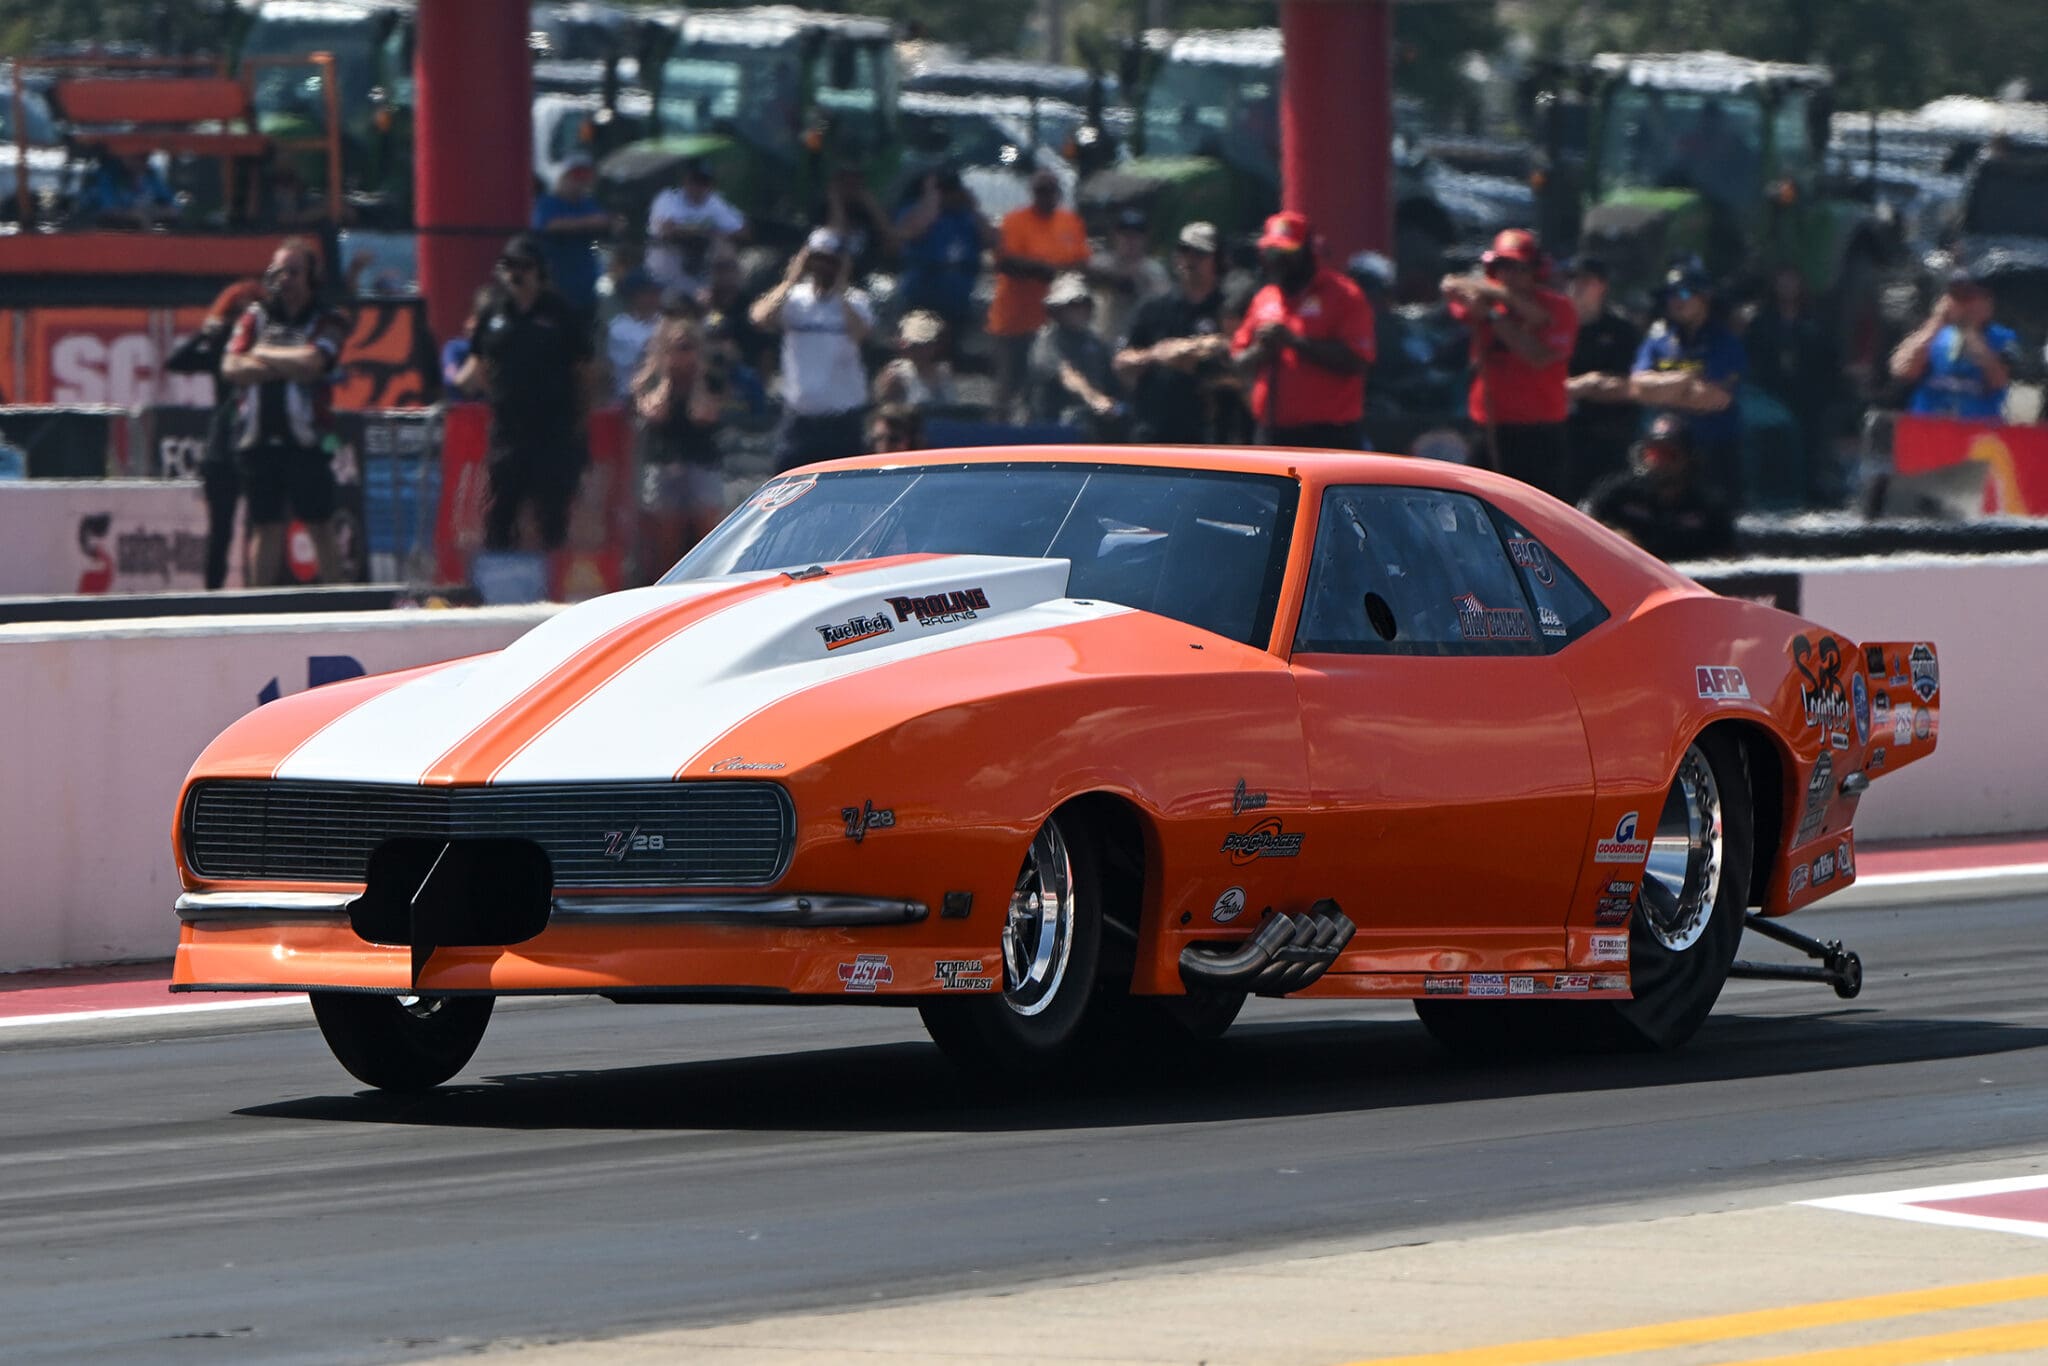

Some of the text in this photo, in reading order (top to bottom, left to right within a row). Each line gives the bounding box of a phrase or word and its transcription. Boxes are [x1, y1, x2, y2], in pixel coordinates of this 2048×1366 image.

[884, 588, 990, 623] PROLINE
[816, 612, 895, 644] FuelTech
[920, 611, 978, 628] RACING
[1697, 668, 1745, 693] ARP
[1599, 843, 1646, 854] GOODRIDGE
[935, 960, 982, 979] KIMBALL
[943, 971, 993, 989] MIDWEST
